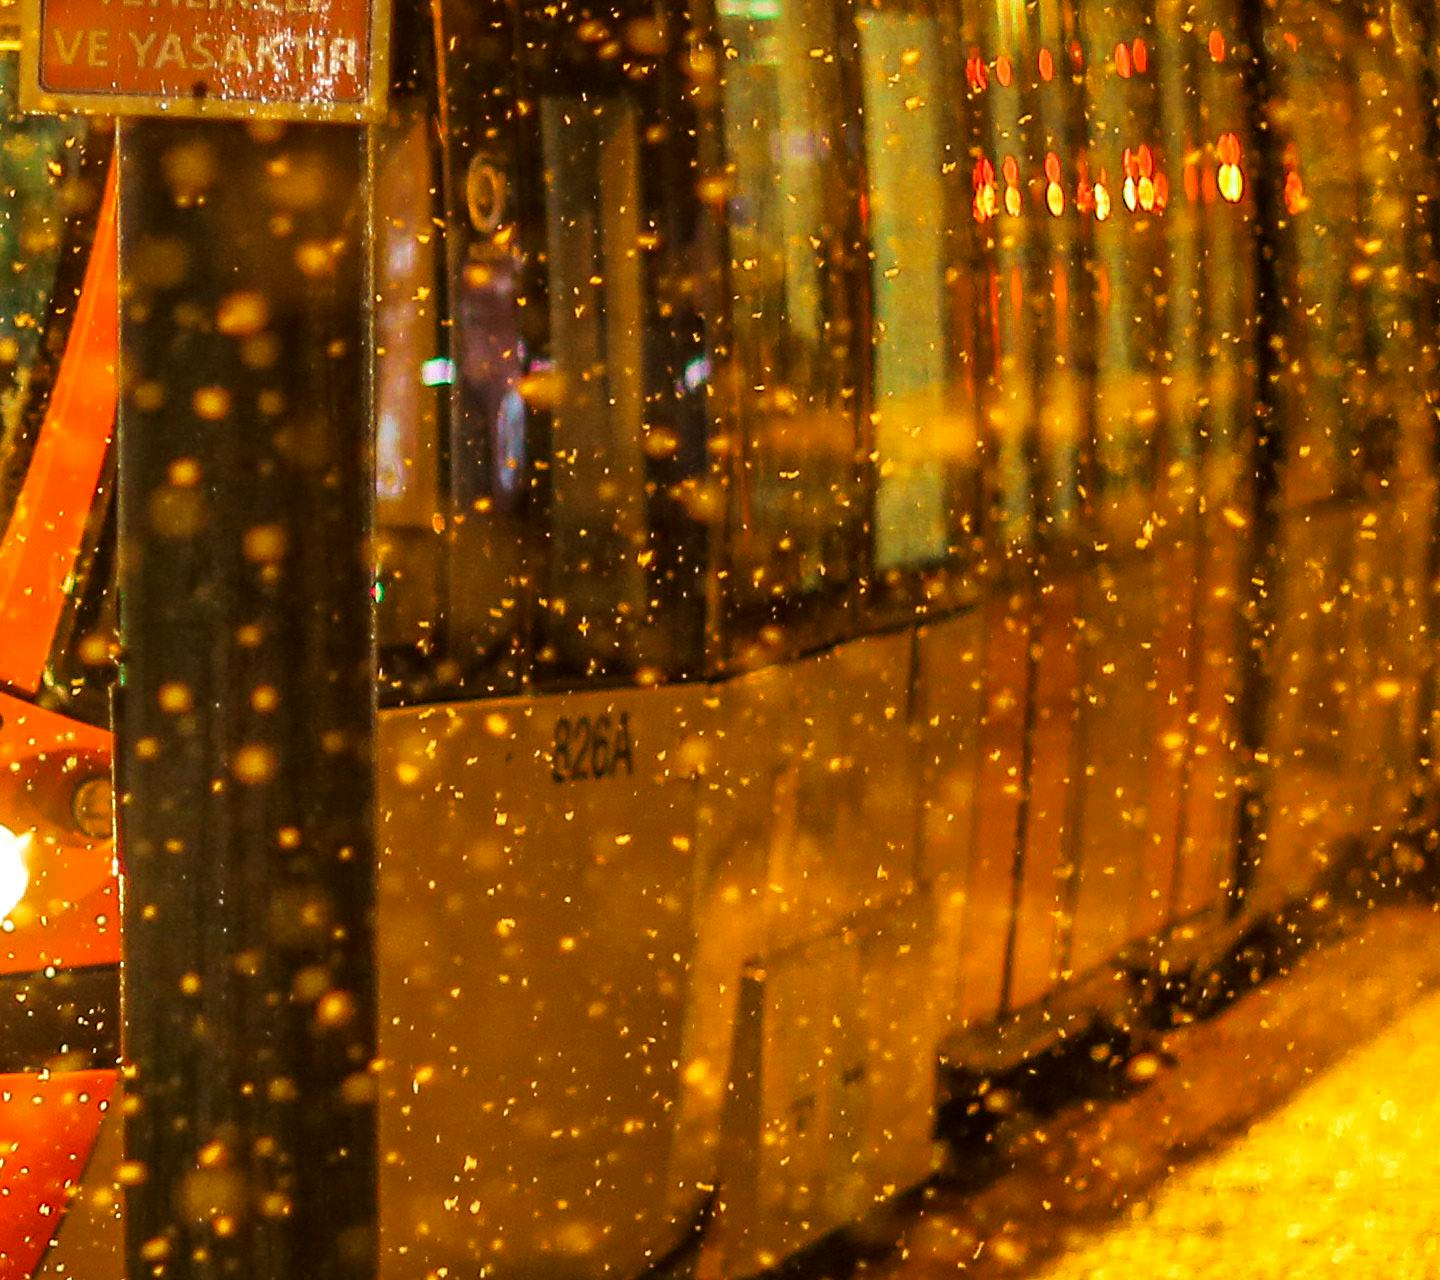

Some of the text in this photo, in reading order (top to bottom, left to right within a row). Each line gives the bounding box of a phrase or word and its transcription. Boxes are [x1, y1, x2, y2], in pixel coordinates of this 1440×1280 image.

[53, 29, 357, 77] VE YASAKTIR
[552, 712, 633, 783] 826A
